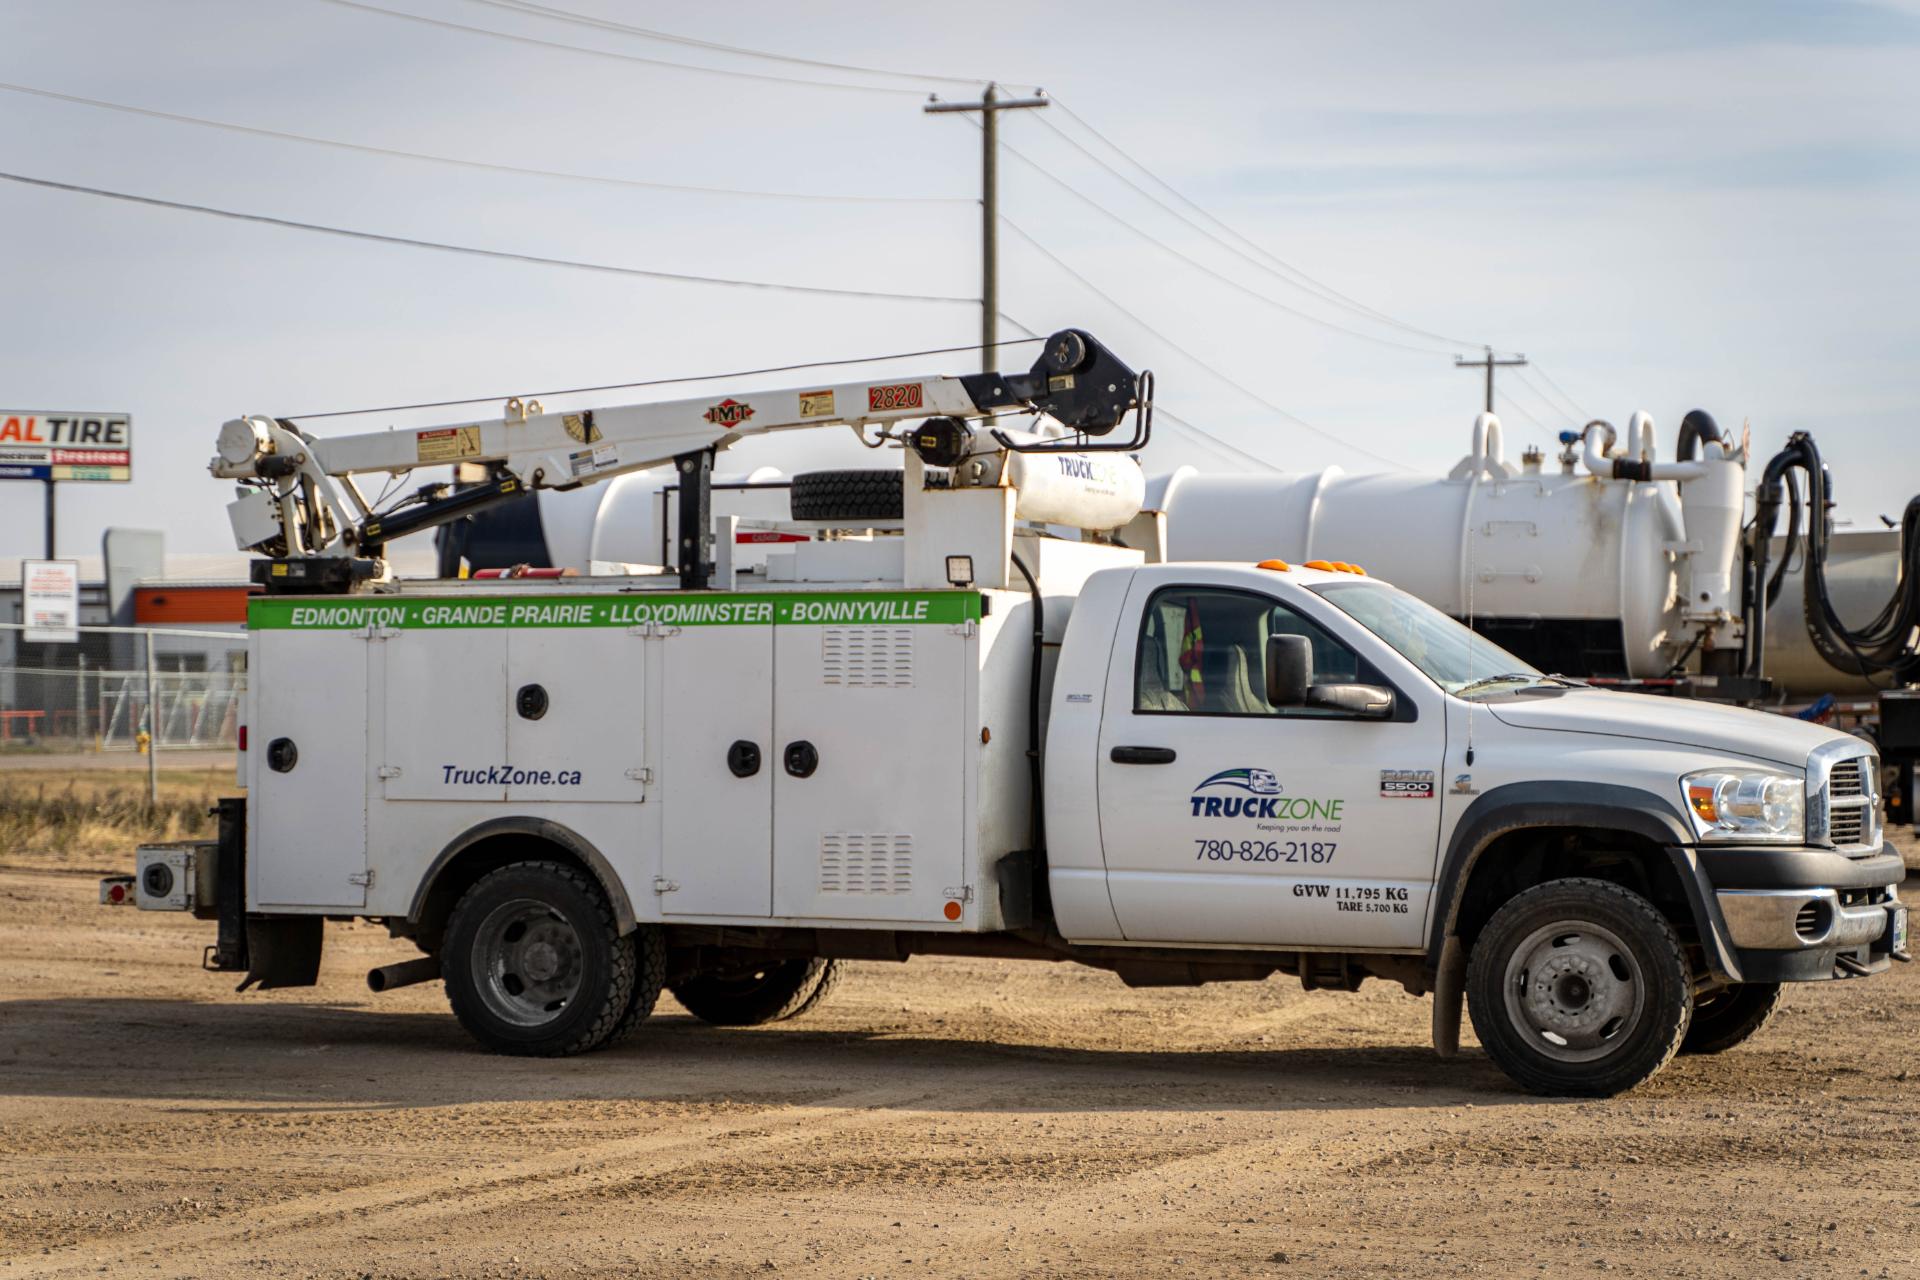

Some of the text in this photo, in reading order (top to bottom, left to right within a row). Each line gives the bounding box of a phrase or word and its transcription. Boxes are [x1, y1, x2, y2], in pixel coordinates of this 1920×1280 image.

[872, 385, 921, 409] 2820
[708, 404, 752, 423] IMT
[46, 418, 126, 443] TIRE
[291, 601, 930, 625] EDMONTON GRANDE PRAIRIE LLOYDMINSTER BONNYVILLE
[442, 765, 582, 785] TruckZone.ca
[1384, 782, 1430, 791] 5500
[1257, 823, 1285, 833] Keeping
[1286, 825, 1299, 833] you
[1311, 824, 1323, 832] the
[1324, 824, 1341, 833] road
[1195, 839, 1337, 863] 780-826-2187
[1293, 884, 1330, 898] GVW
[1385, 887, 1409, 901] KG
[1336, 901, 1363, 912] TARE
[1393, 903, 1408, 913] KG
